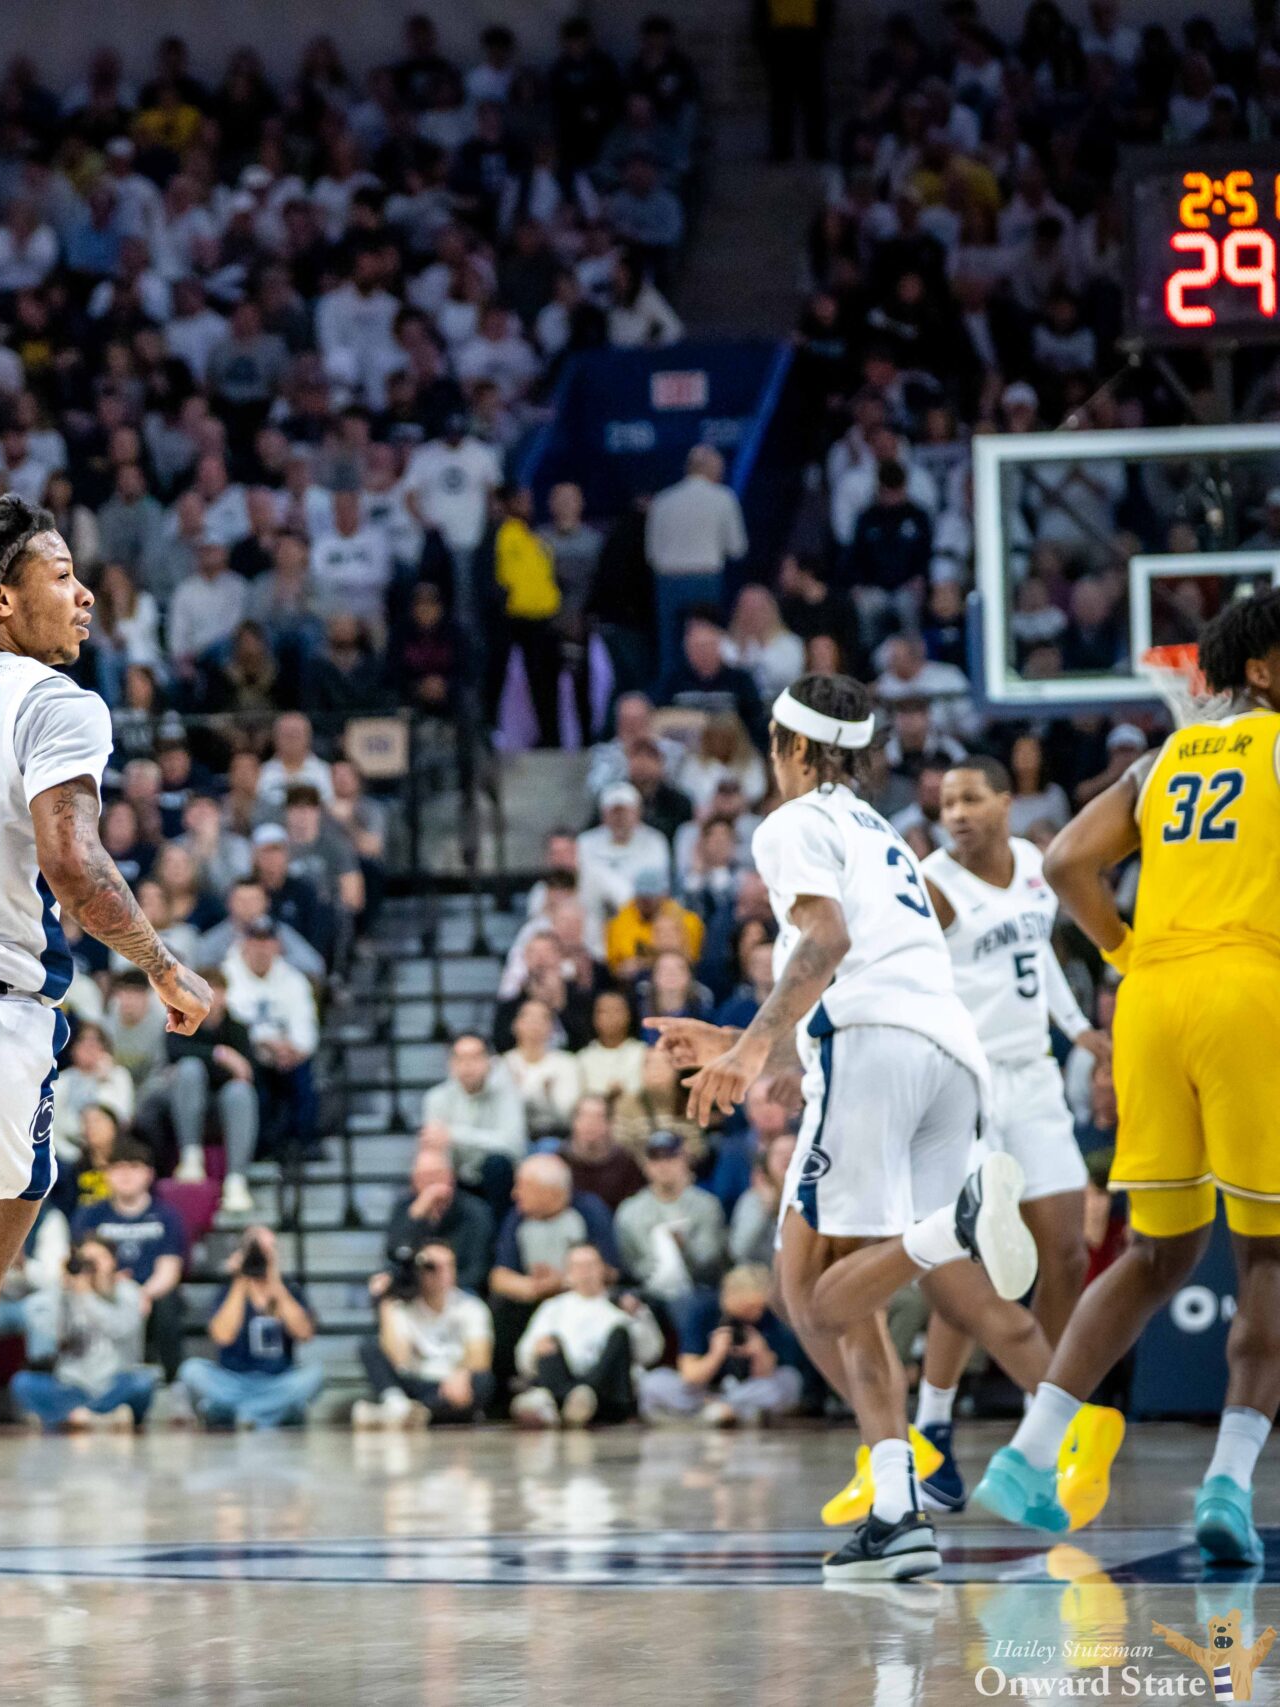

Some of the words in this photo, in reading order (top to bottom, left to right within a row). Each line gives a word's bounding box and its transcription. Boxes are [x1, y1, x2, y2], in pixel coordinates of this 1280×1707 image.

[1165, 228, 1277, 328] 29
[1179, 736, 1227, 759] REED
[1162, 768, 1246, 845] 32
[887, 846, 931, 918] 3
[973, 917, 1019, 961] PENN
[1013, 951, 1039, 998] 5
